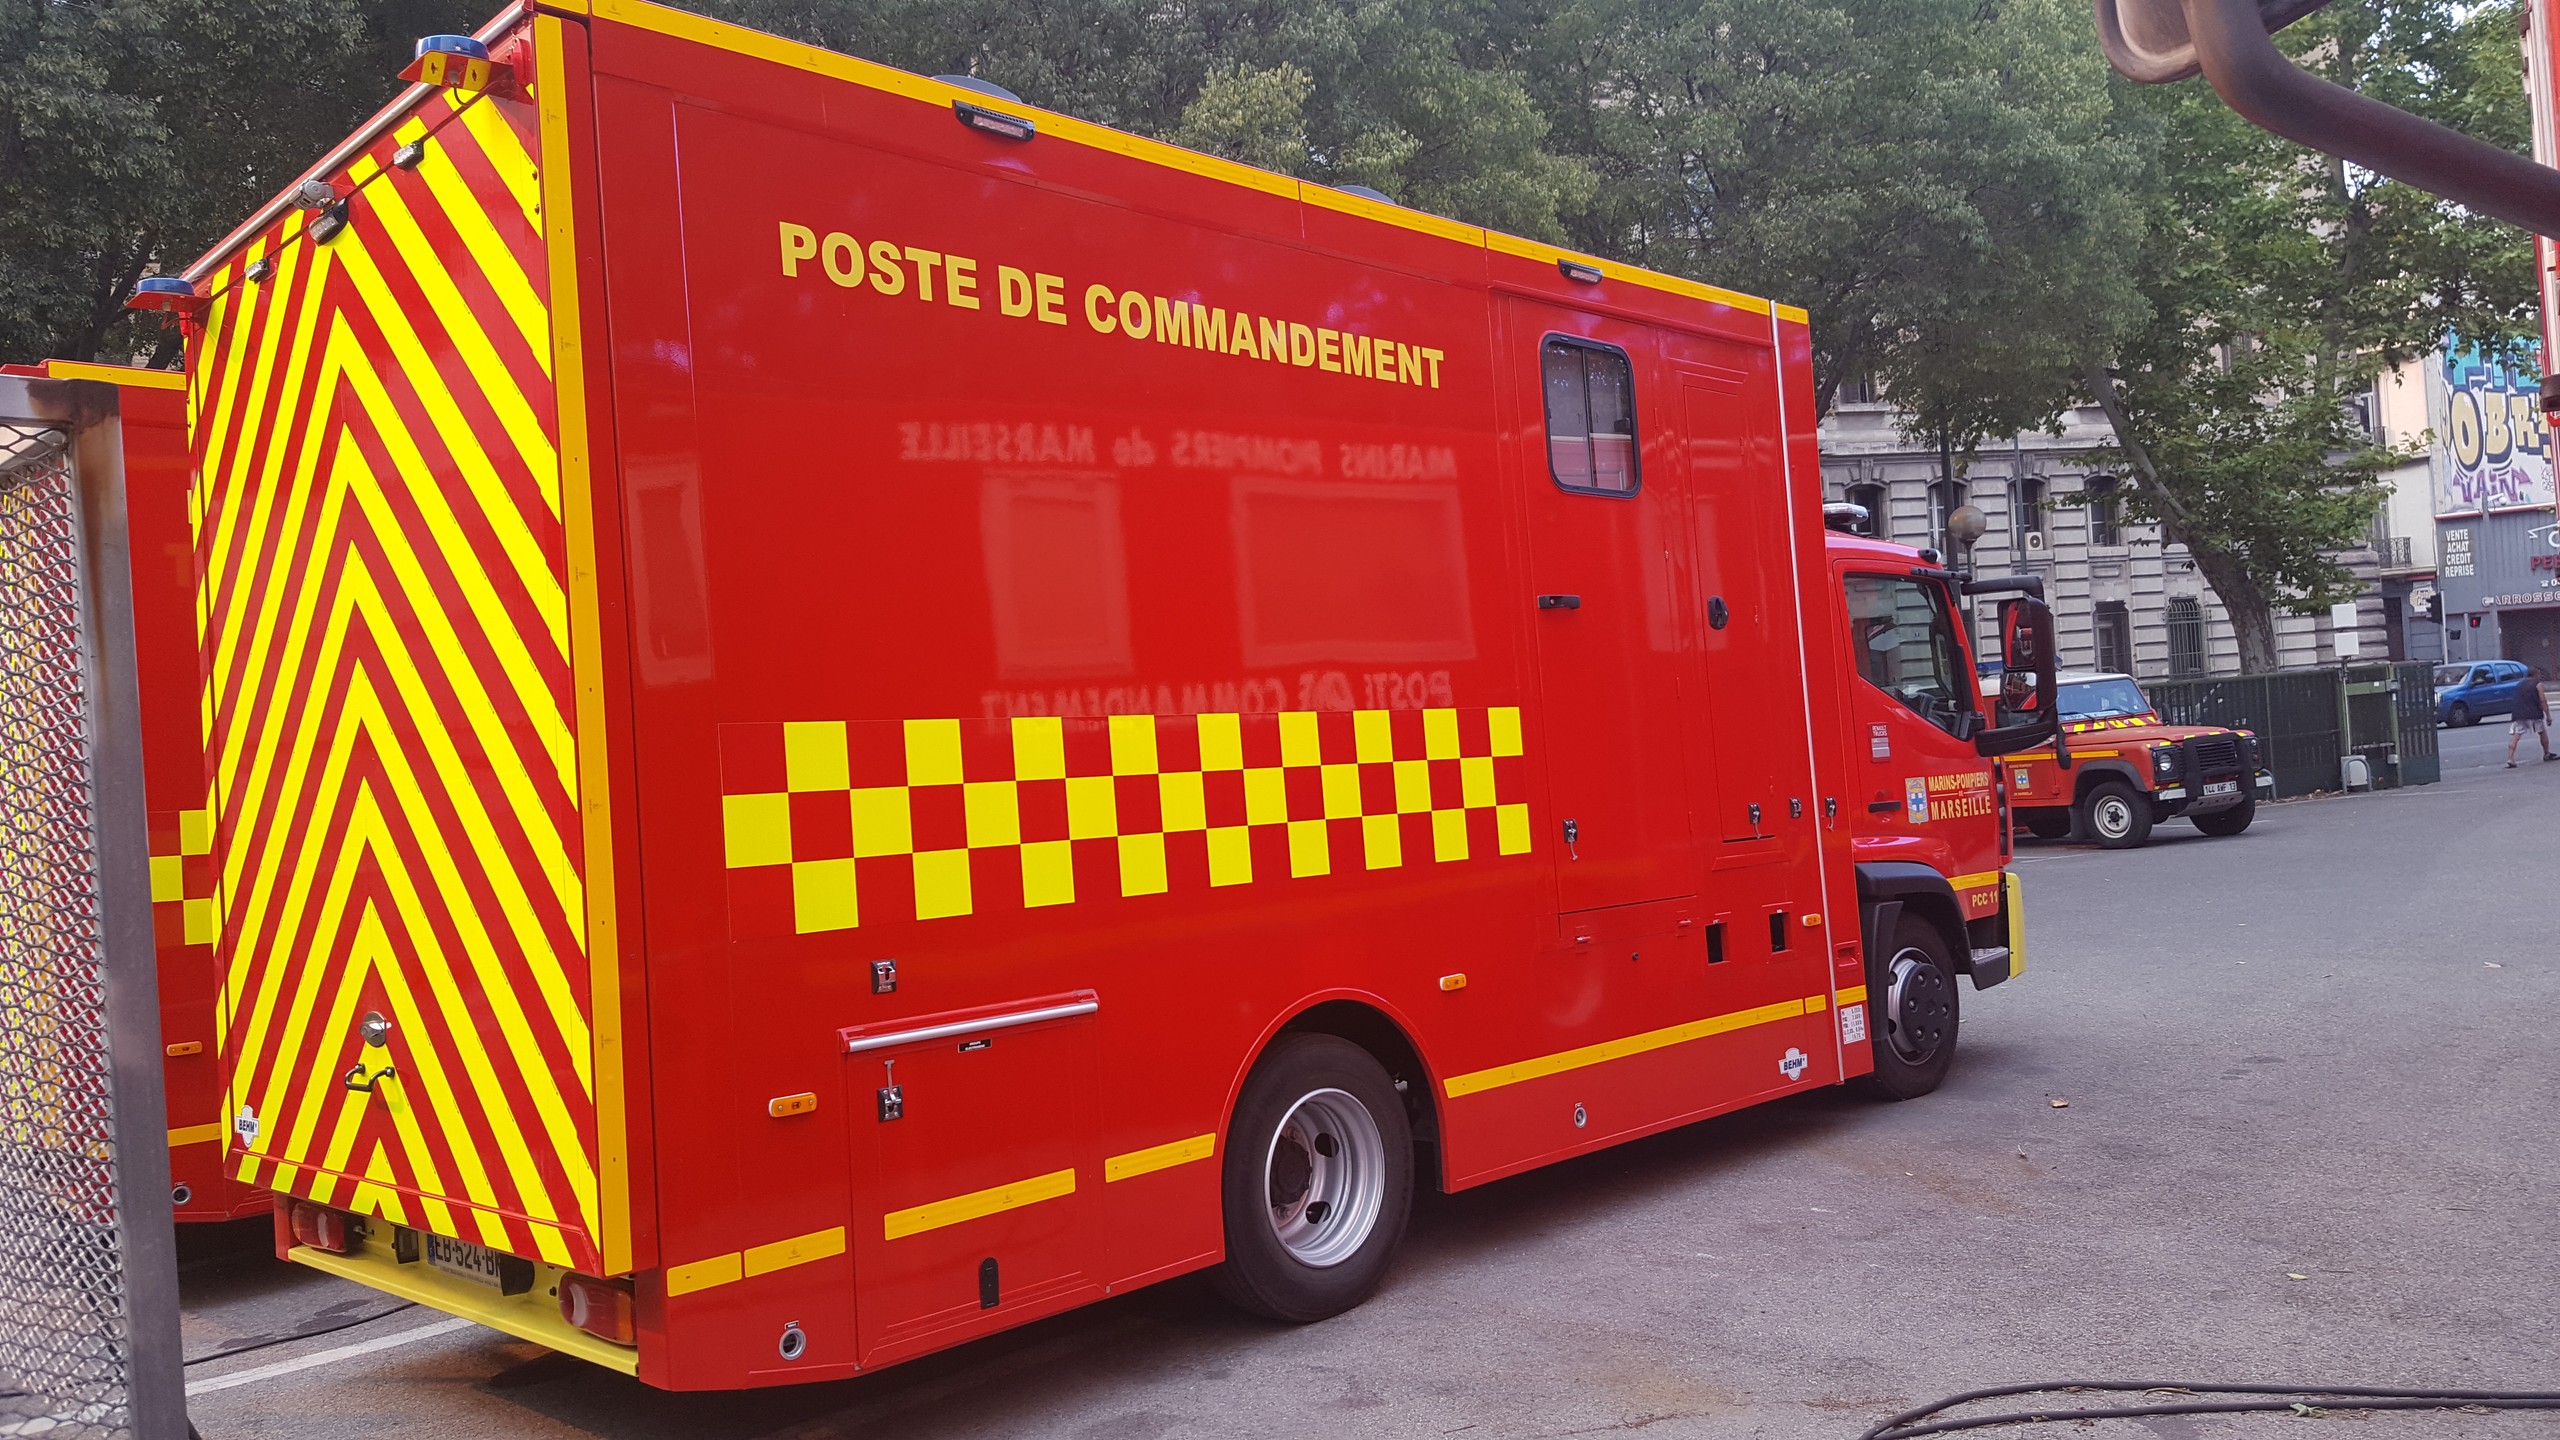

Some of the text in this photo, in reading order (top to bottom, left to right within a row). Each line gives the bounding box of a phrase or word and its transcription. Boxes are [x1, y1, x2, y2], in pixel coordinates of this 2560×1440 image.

[779, 221, 1445, 389] POSTE DE COMMANDEMENT
[2445, 529, 2469, 541] VENTE
[2447, 541, 2470, 553] ACHAT
[2446, 553, 2471, 565] CREDIT
[2445, 564, 2474, 578] REPRISE
[1928, 772, 1989, 791] MARINS-POMPIERS
[1930, 796, 1992, 820] MARSEILLE
[1972, 890, 1998, 908] PCC 11
[1783, 1058, 1803, 1071] BEHM
